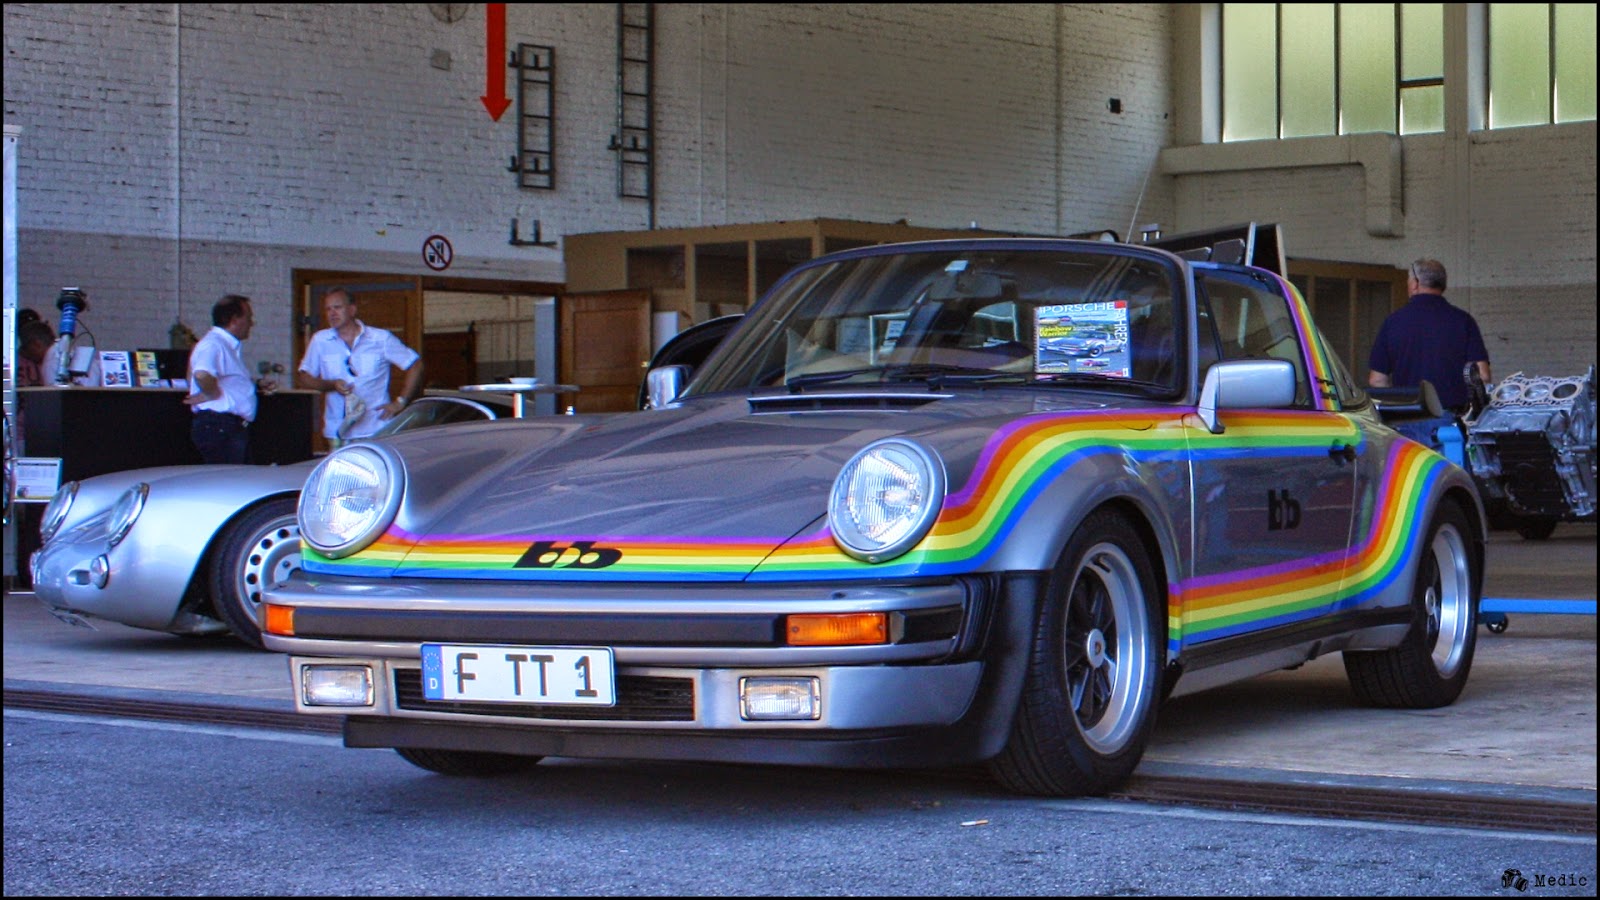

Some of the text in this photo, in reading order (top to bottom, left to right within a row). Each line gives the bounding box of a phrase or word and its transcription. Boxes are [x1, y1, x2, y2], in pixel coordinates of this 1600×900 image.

[1043, 302, 1114, 314] PORSCHE
[1114, 308, 1128, 345] FAHRER
[1268, 489, 1301, 530] bb
[512, 541, 623, 569] bb
[429, 677, 438, 690] D
[457, 653, 598, 697] F TT 1
